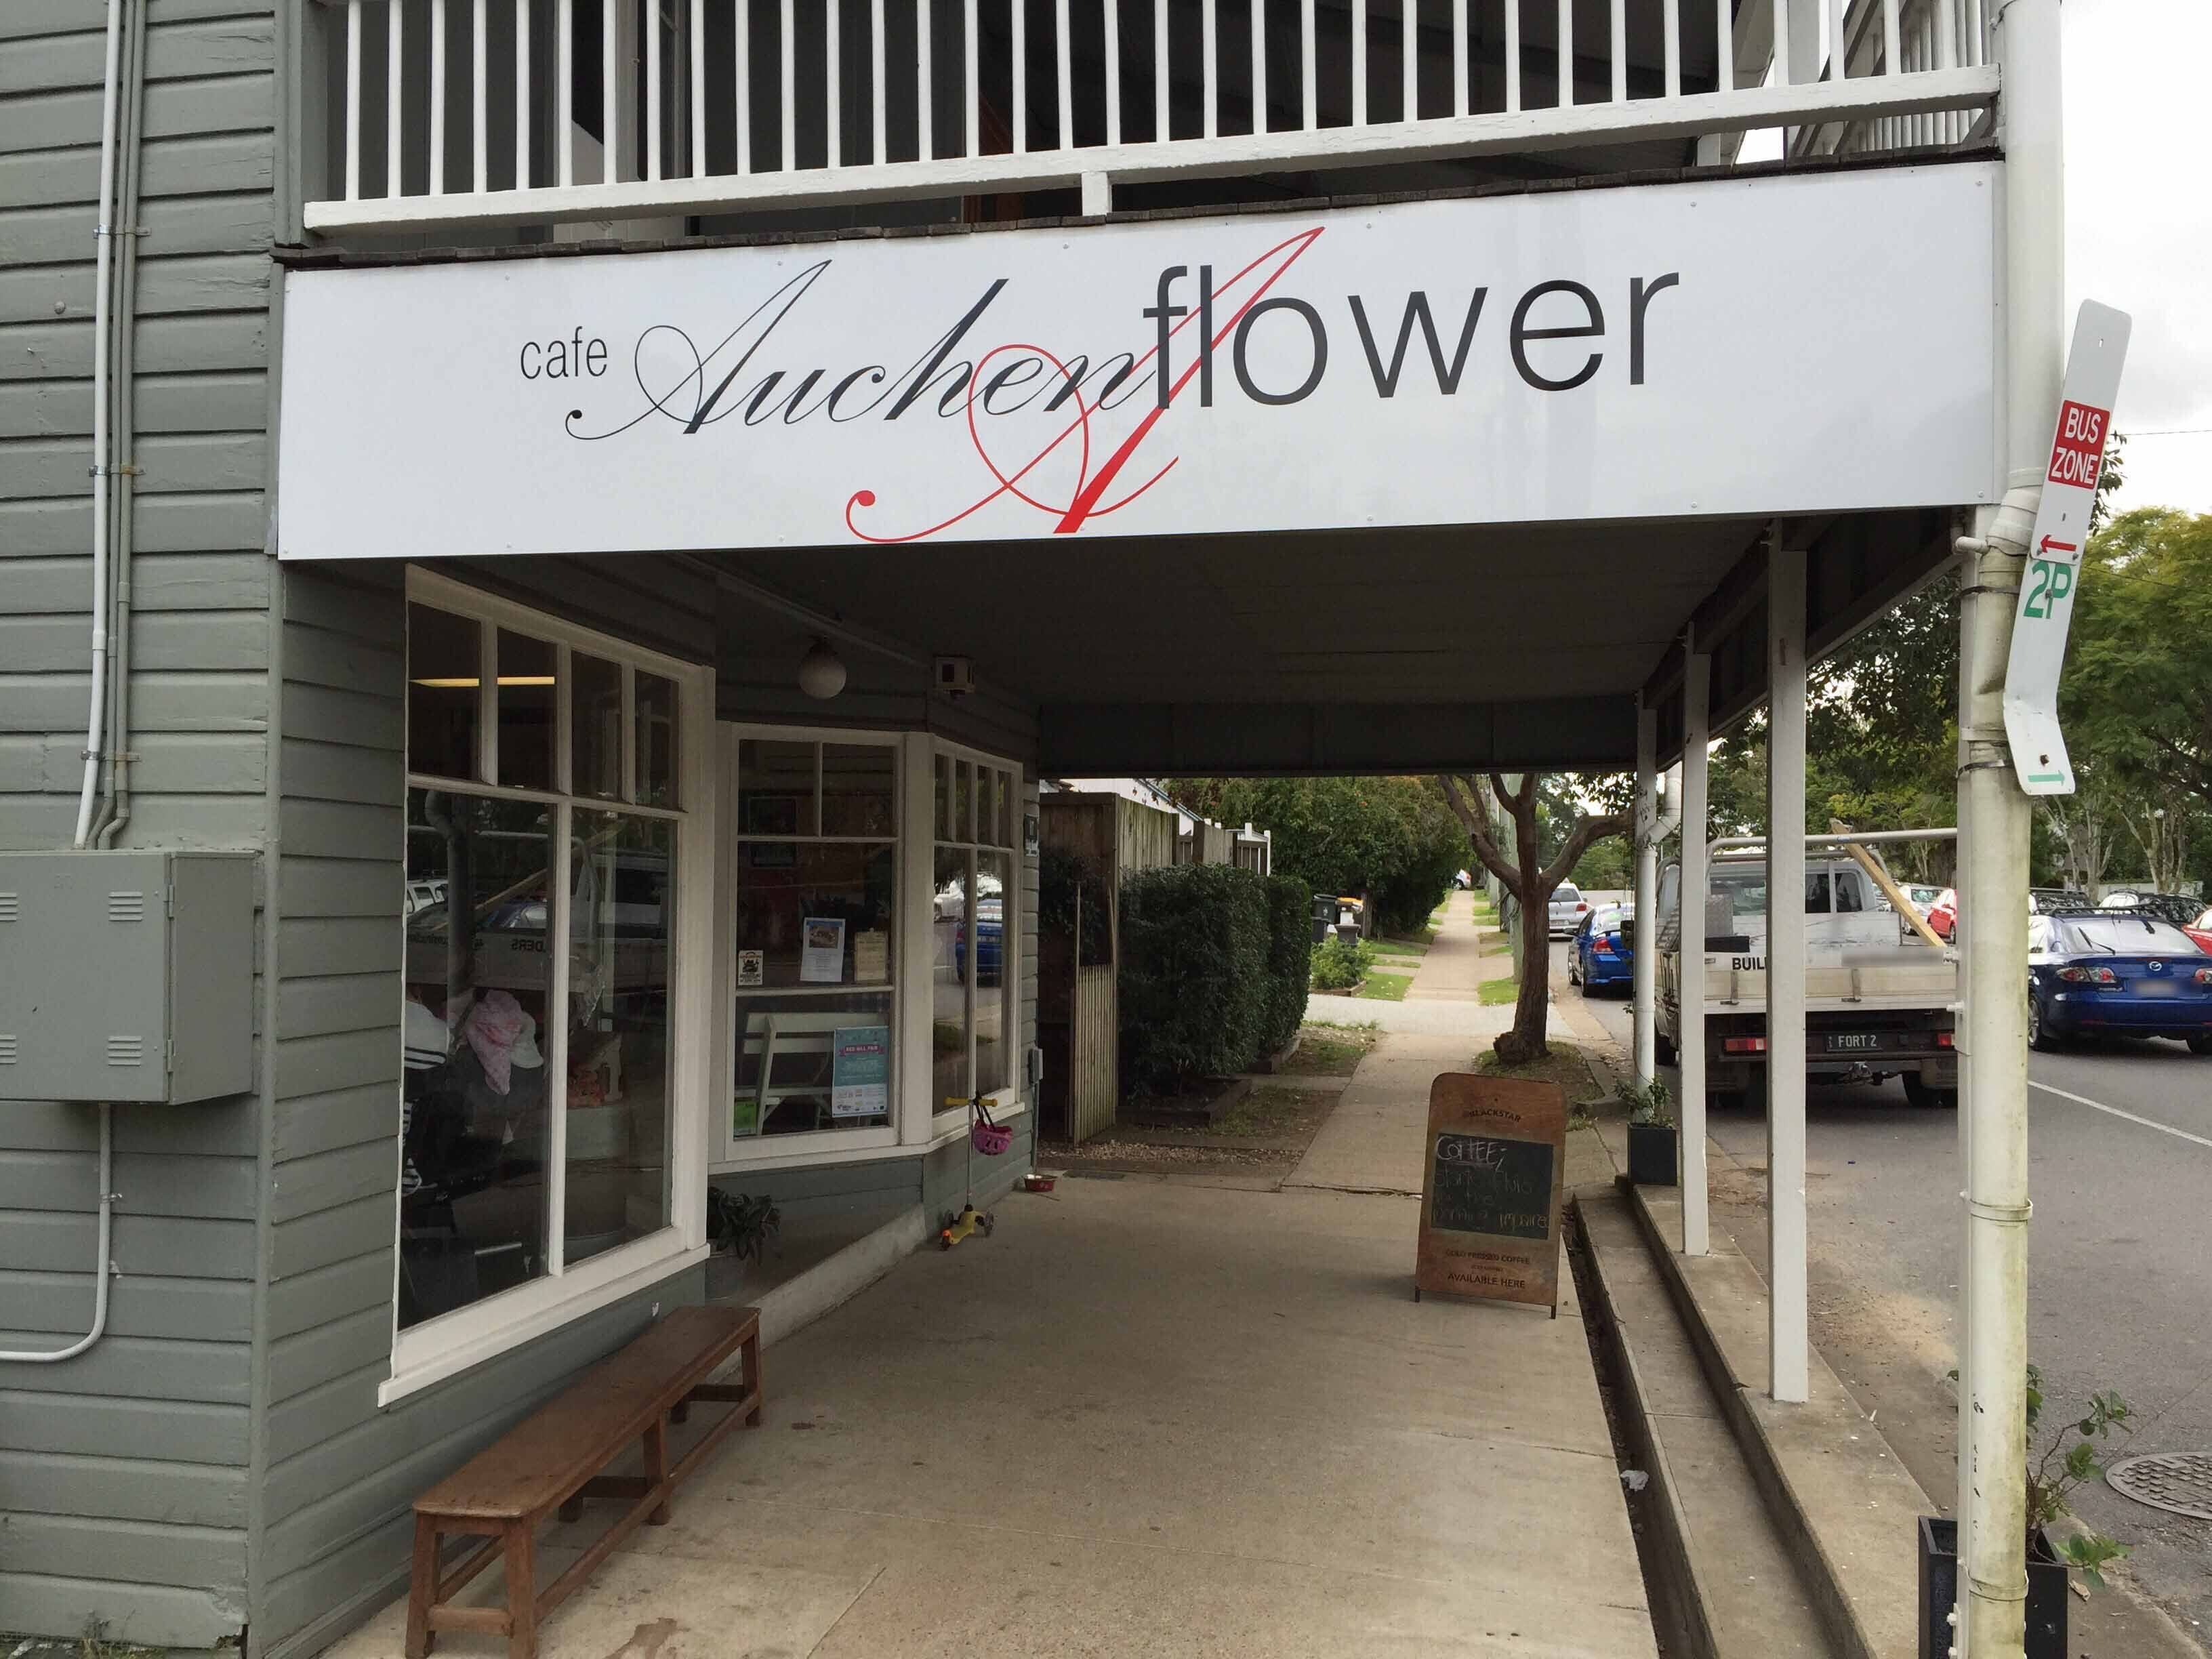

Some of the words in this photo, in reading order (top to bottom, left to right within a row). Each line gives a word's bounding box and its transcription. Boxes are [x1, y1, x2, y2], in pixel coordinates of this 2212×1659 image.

[520, 325, 609, 380] cafe
[2065, 407, 2102, 444] BUS
[2051, 446, 2099, 485] ZONE
[2023, 560, 2072, 619] 2P
[1732, 956, 1767, 970] BUIL
[1837, 1034, 1867, 1048] FORT
[1870, 1033, 1877, 1047] 2
[1469, 1108, 1522, 1123] BLACKSTAR
[1501, 1254, 1530, 1265] COFFEE
[1447, 1273, 1498, 1286] AVAILABLE
[1500, 1278, 1526, 1289] HERE
